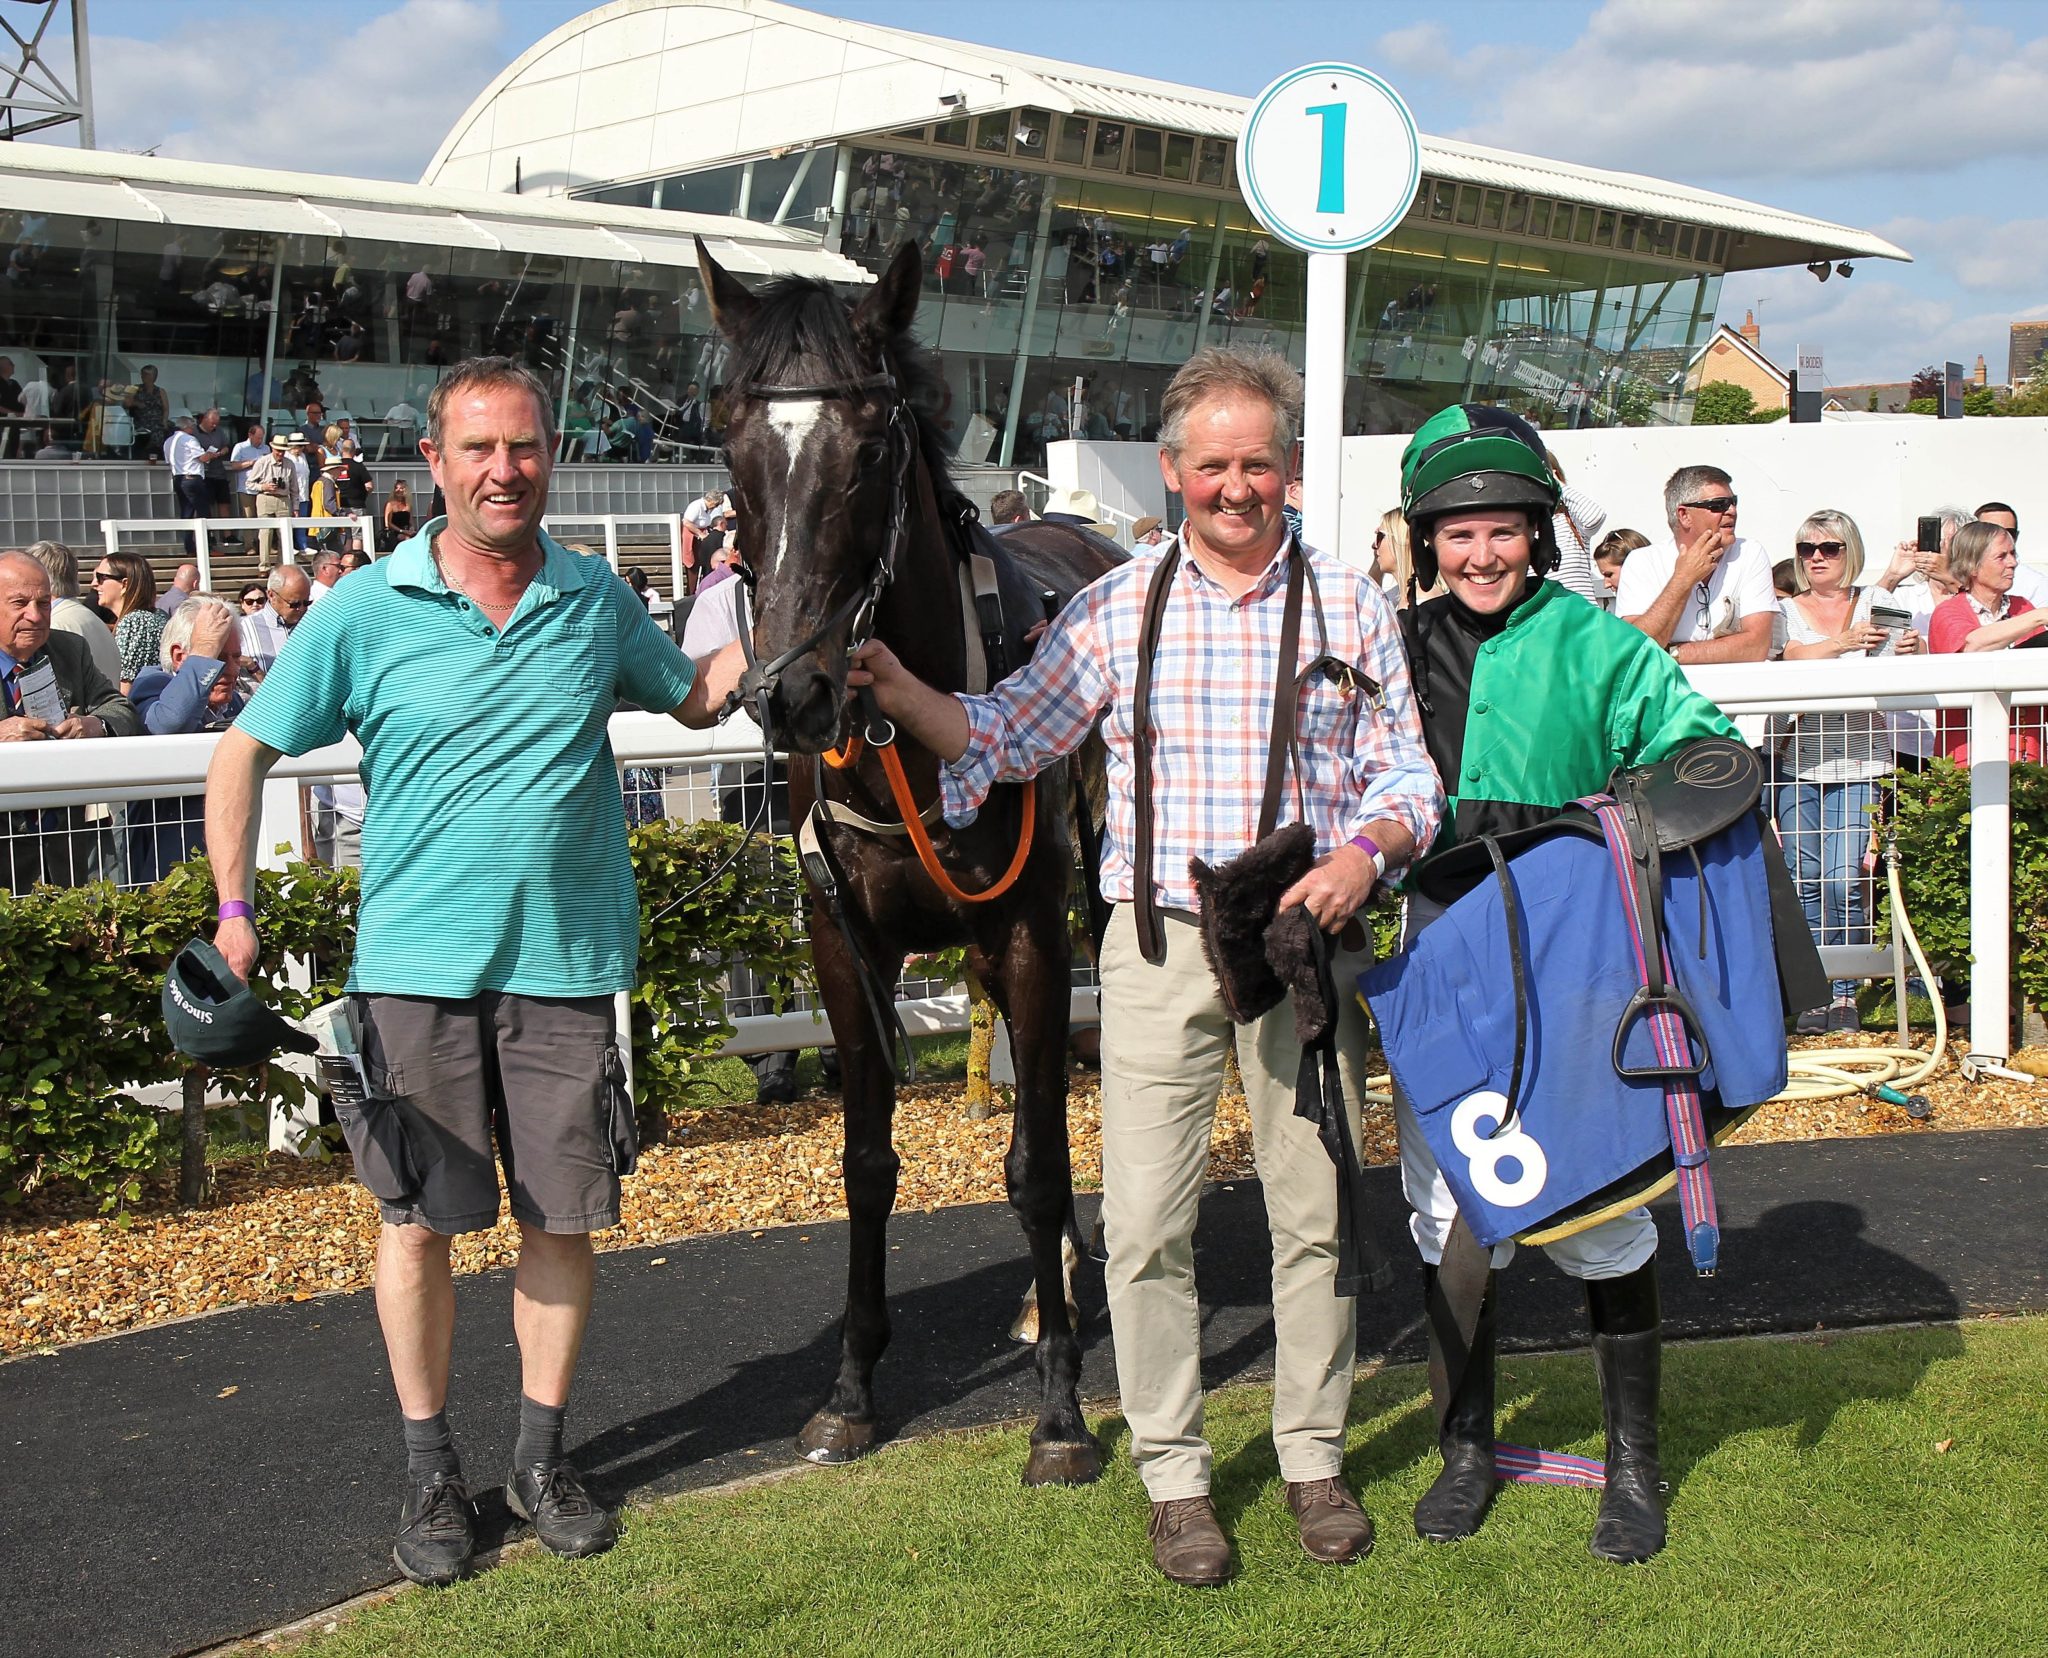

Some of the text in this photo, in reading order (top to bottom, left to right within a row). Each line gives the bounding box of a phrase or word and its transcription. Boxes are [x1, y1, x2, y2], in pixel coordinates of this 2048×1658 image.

[1305, 102, 1347, 214] 1
[169, 979, 213, 1024] Since 1866
[1450, 1090, 1548, 1208] 8
